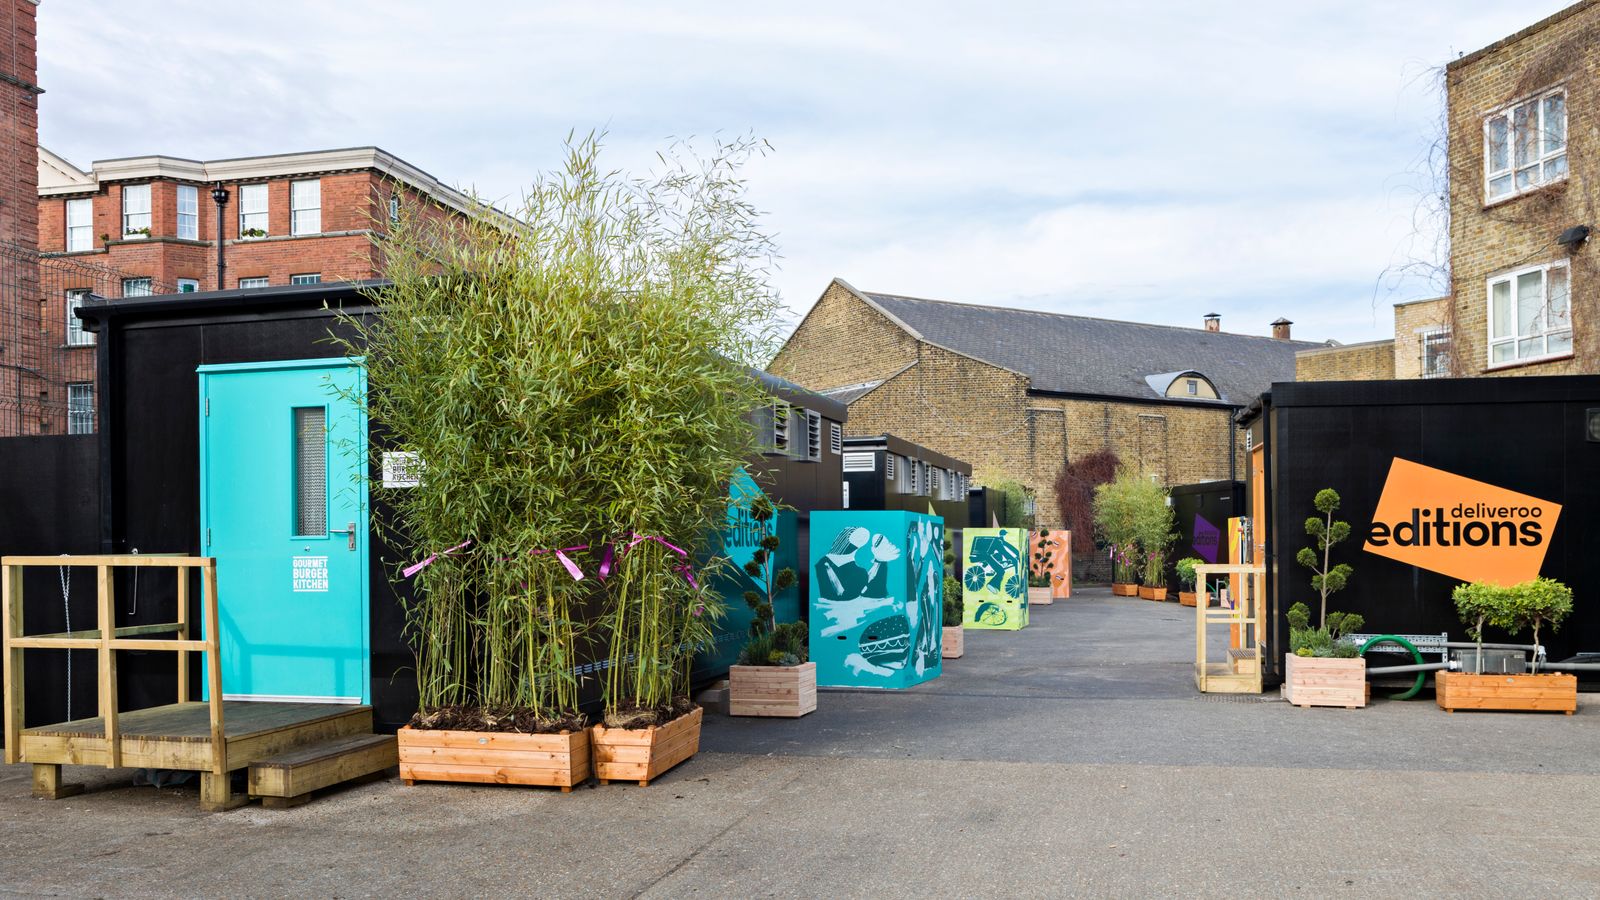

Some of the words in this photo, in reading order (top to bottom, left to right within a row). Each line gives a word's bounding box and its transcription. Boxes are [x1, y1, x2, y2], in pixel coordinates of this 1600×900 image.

[1450, 503, 1542, 518] deliveroo
[1366, 507, 1543, 547] editions
[293, 559, 328, 568] GOURMET
[293, 568, 328, 579] BURGER
[293, 579, 329, 589] KITCHEN
